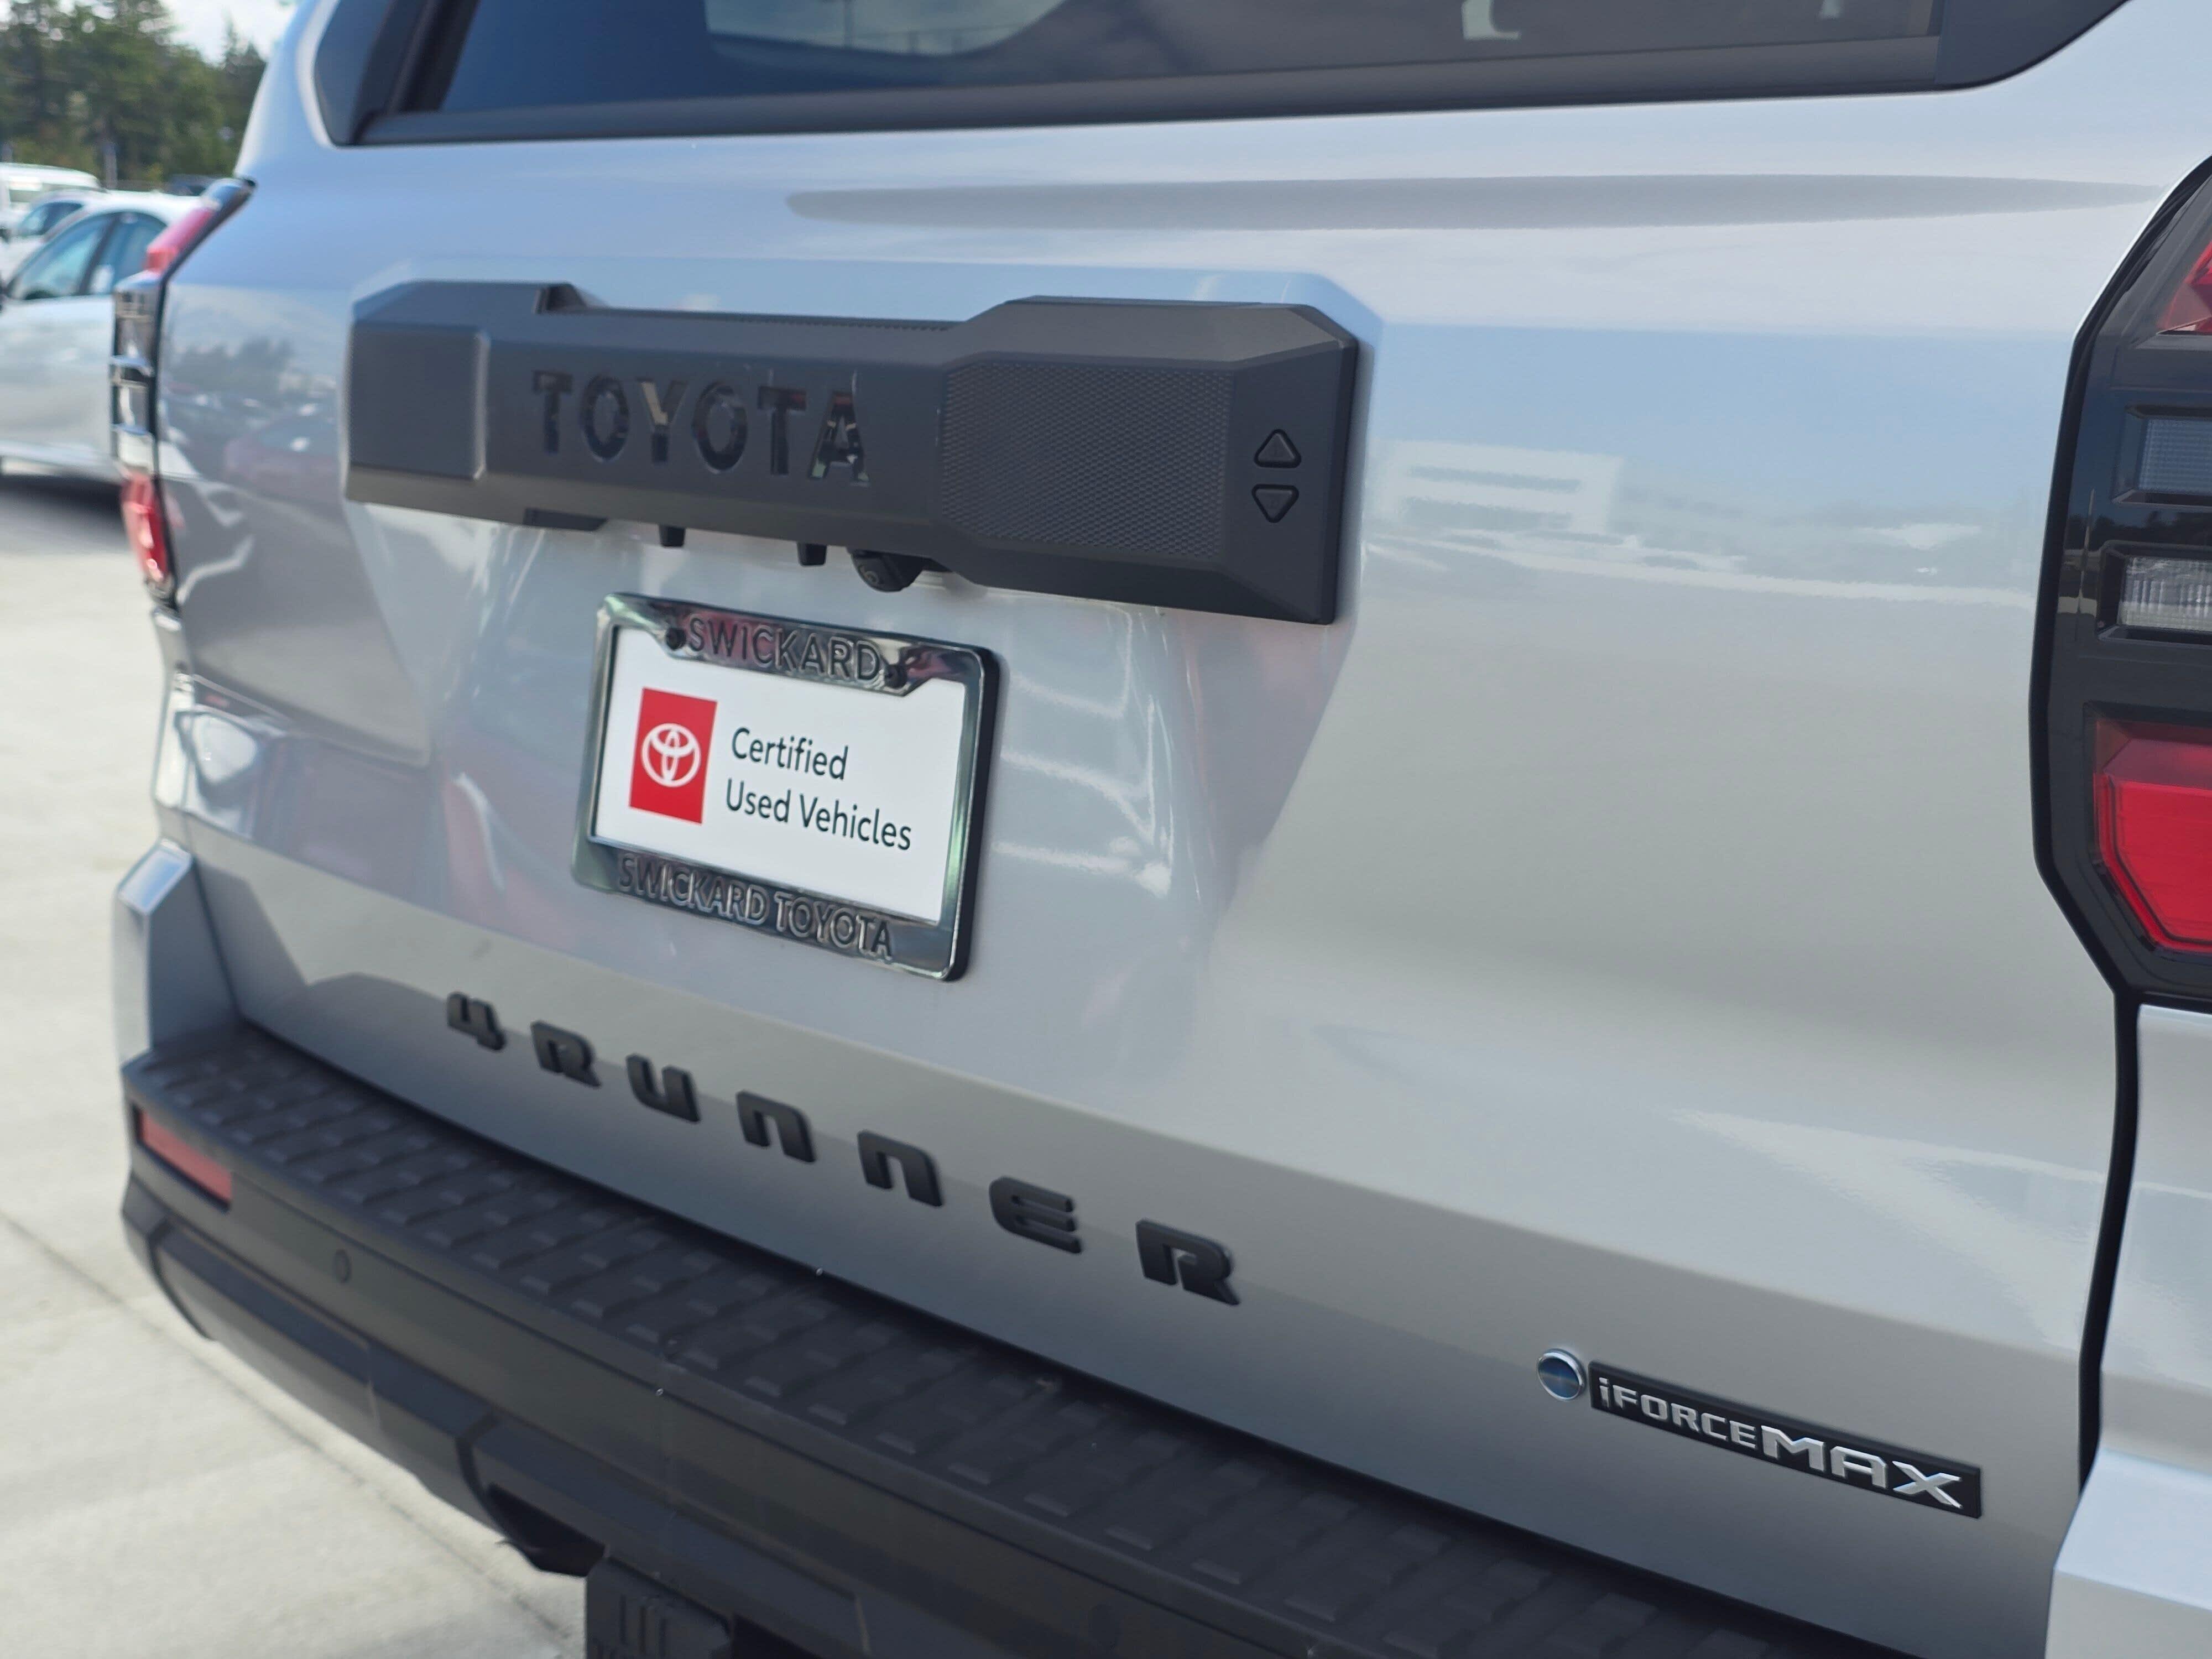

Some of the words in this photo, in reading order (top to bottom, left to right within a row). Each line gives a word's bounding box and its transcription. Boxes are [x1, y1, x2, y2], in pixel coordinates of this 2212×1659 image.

[532, 369, 870, 487] TOYOTA
[685, 615, 881, 682] SWICKARD
[732, 727, 848, 780] Certified
[726, 779, 790, 824] Used
[800, 795, 911, 851] Vehicles
[618, 855, 769, 924] SWICKARD
[775, 893, 893, 959] TOYOTA
